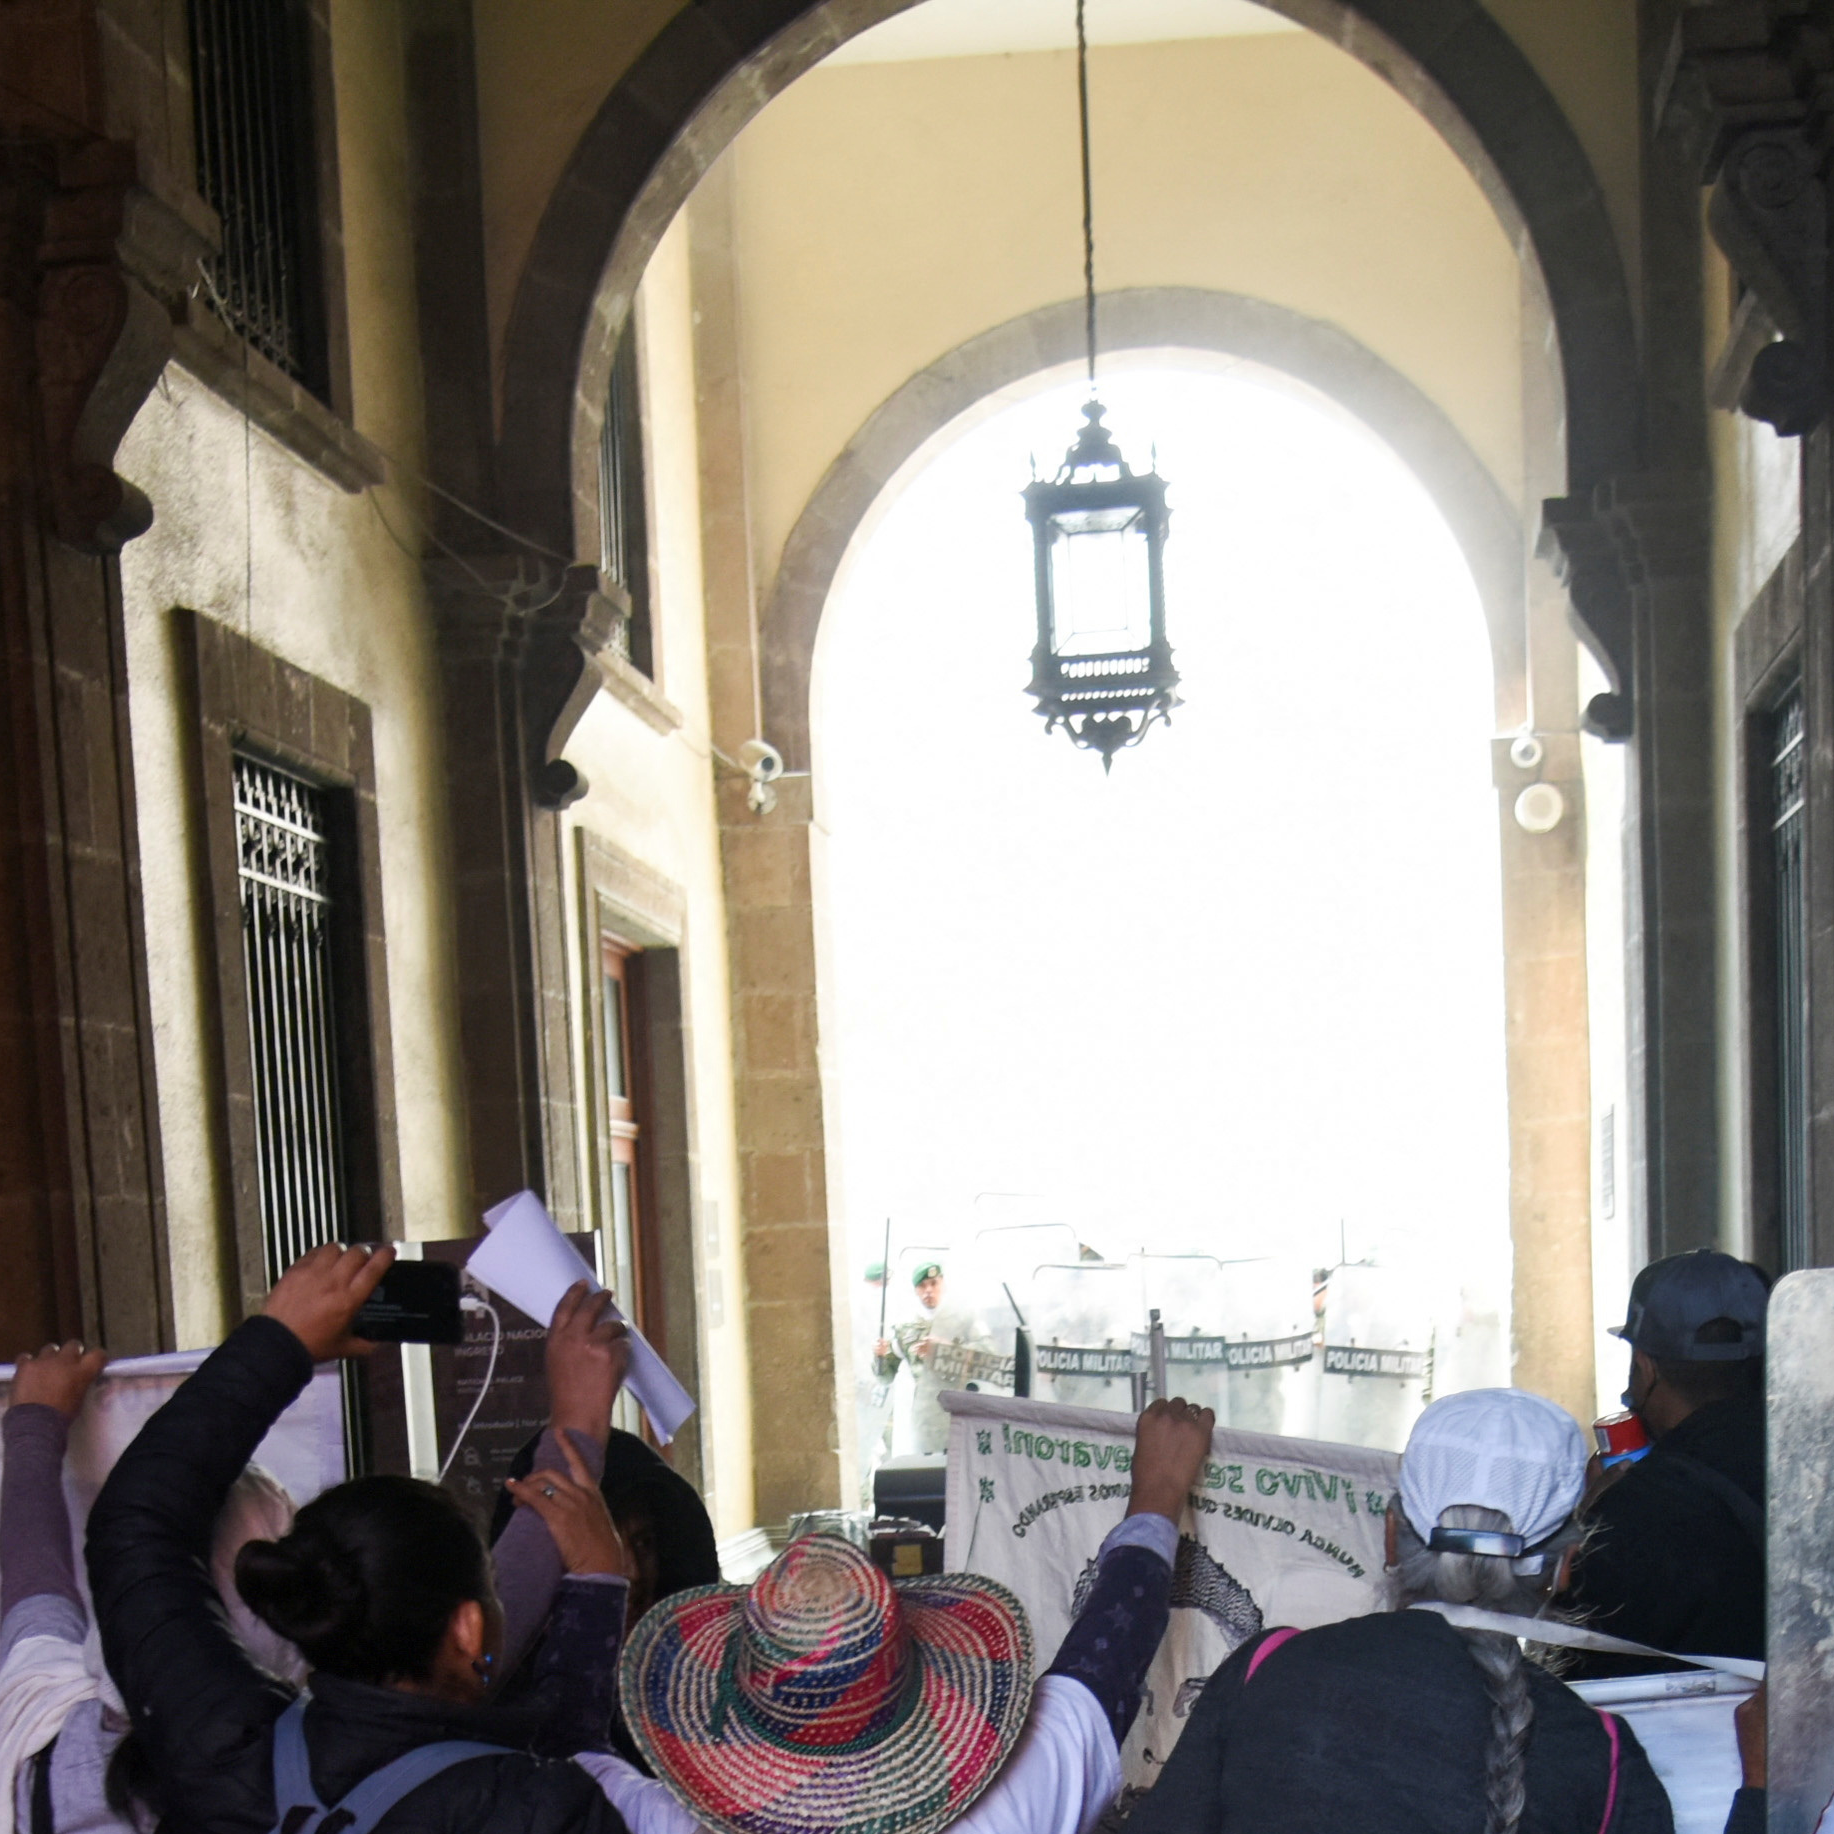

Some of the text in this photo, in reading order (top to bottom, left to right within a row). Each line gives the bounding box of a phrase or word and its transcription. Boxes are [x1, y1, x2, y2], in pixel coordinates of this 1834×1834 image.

[1037, 1349, 1079, 1371] OLICIA
[1227, 1345, 1273, 1365] OLICIA
[1326, 1349, 1378, 1372] POLICIA
